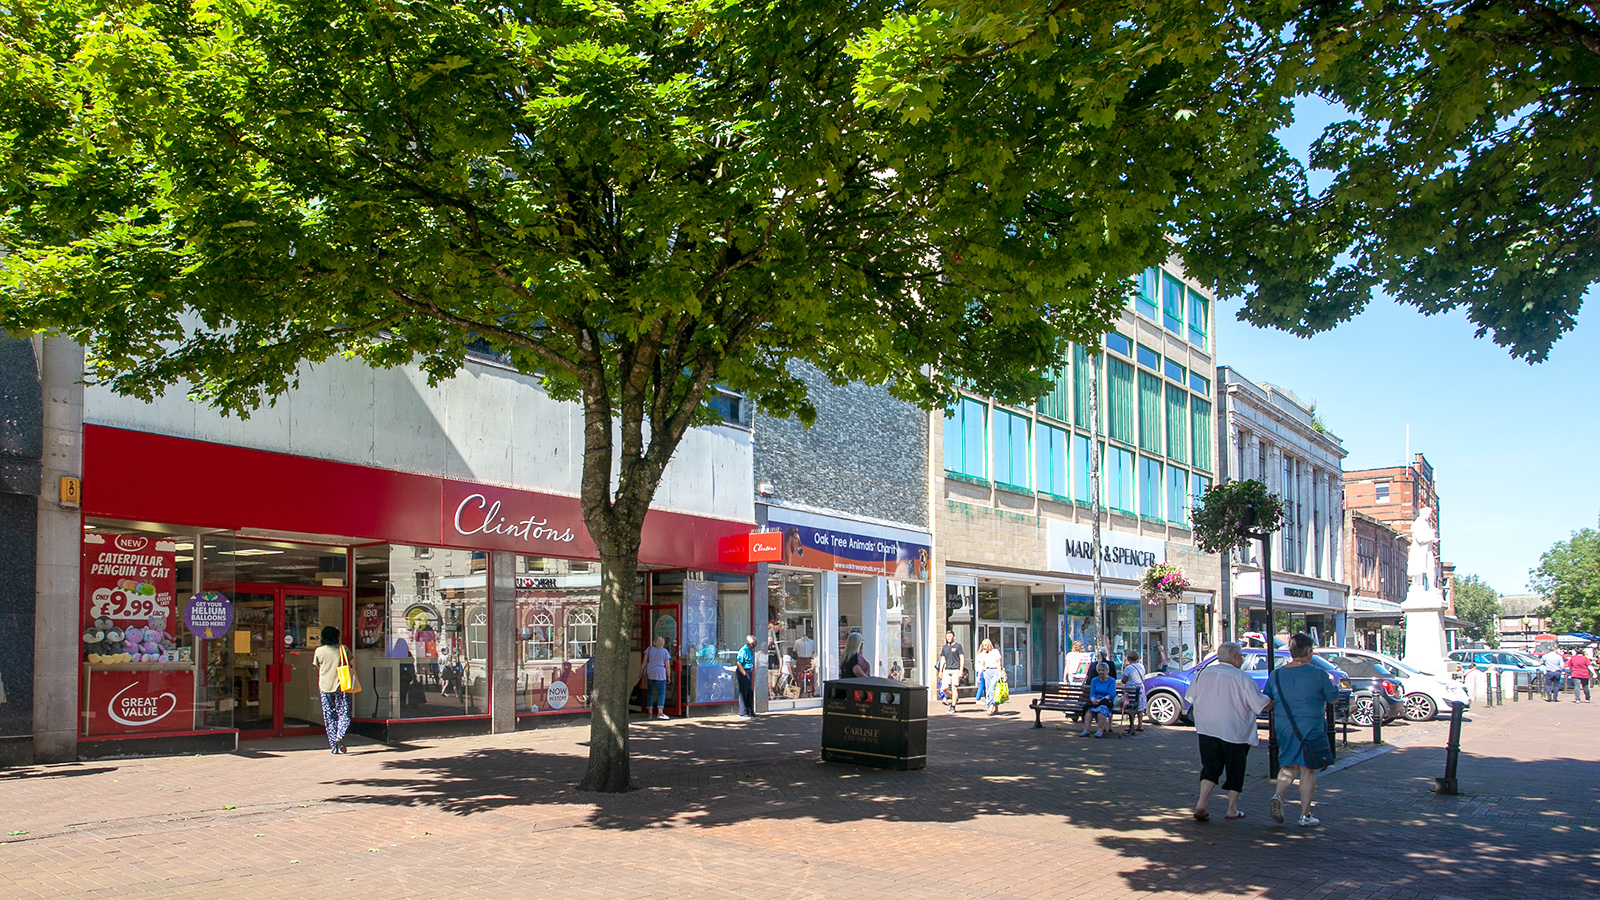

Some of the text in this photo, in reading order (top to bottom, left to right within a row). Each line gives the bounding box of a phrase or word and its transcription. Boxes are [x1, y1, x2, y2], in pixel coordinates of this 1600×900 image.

[454, 493, 575, 542] Clintons
[120, 539, 142, 547] NEW
[753, 543, 777, 552] Clintons
[814, 532, 830, 545] Oak
[831, 535, 847, 547] Tree
[877, 542, 898, 555] Charity
[98, 552, 163, 566] CATERPILLAR
[1104, 545, 1111, 562] &
[1112, 546, 1156, 567] SPENCER
[91, 563, 170, 578] PENGUIN & CAT
[100, 591, 153, 617] £9.99
[191, 607, 226, 615] HELIUM
[707, 608, 714, 624] 2
[549, 687, 567, 695] NOW
[121, 697, 158, 707] GREAT
[121, 707, 158, 717] VALUE
[844, 726, 880, 738] CARLISLE
